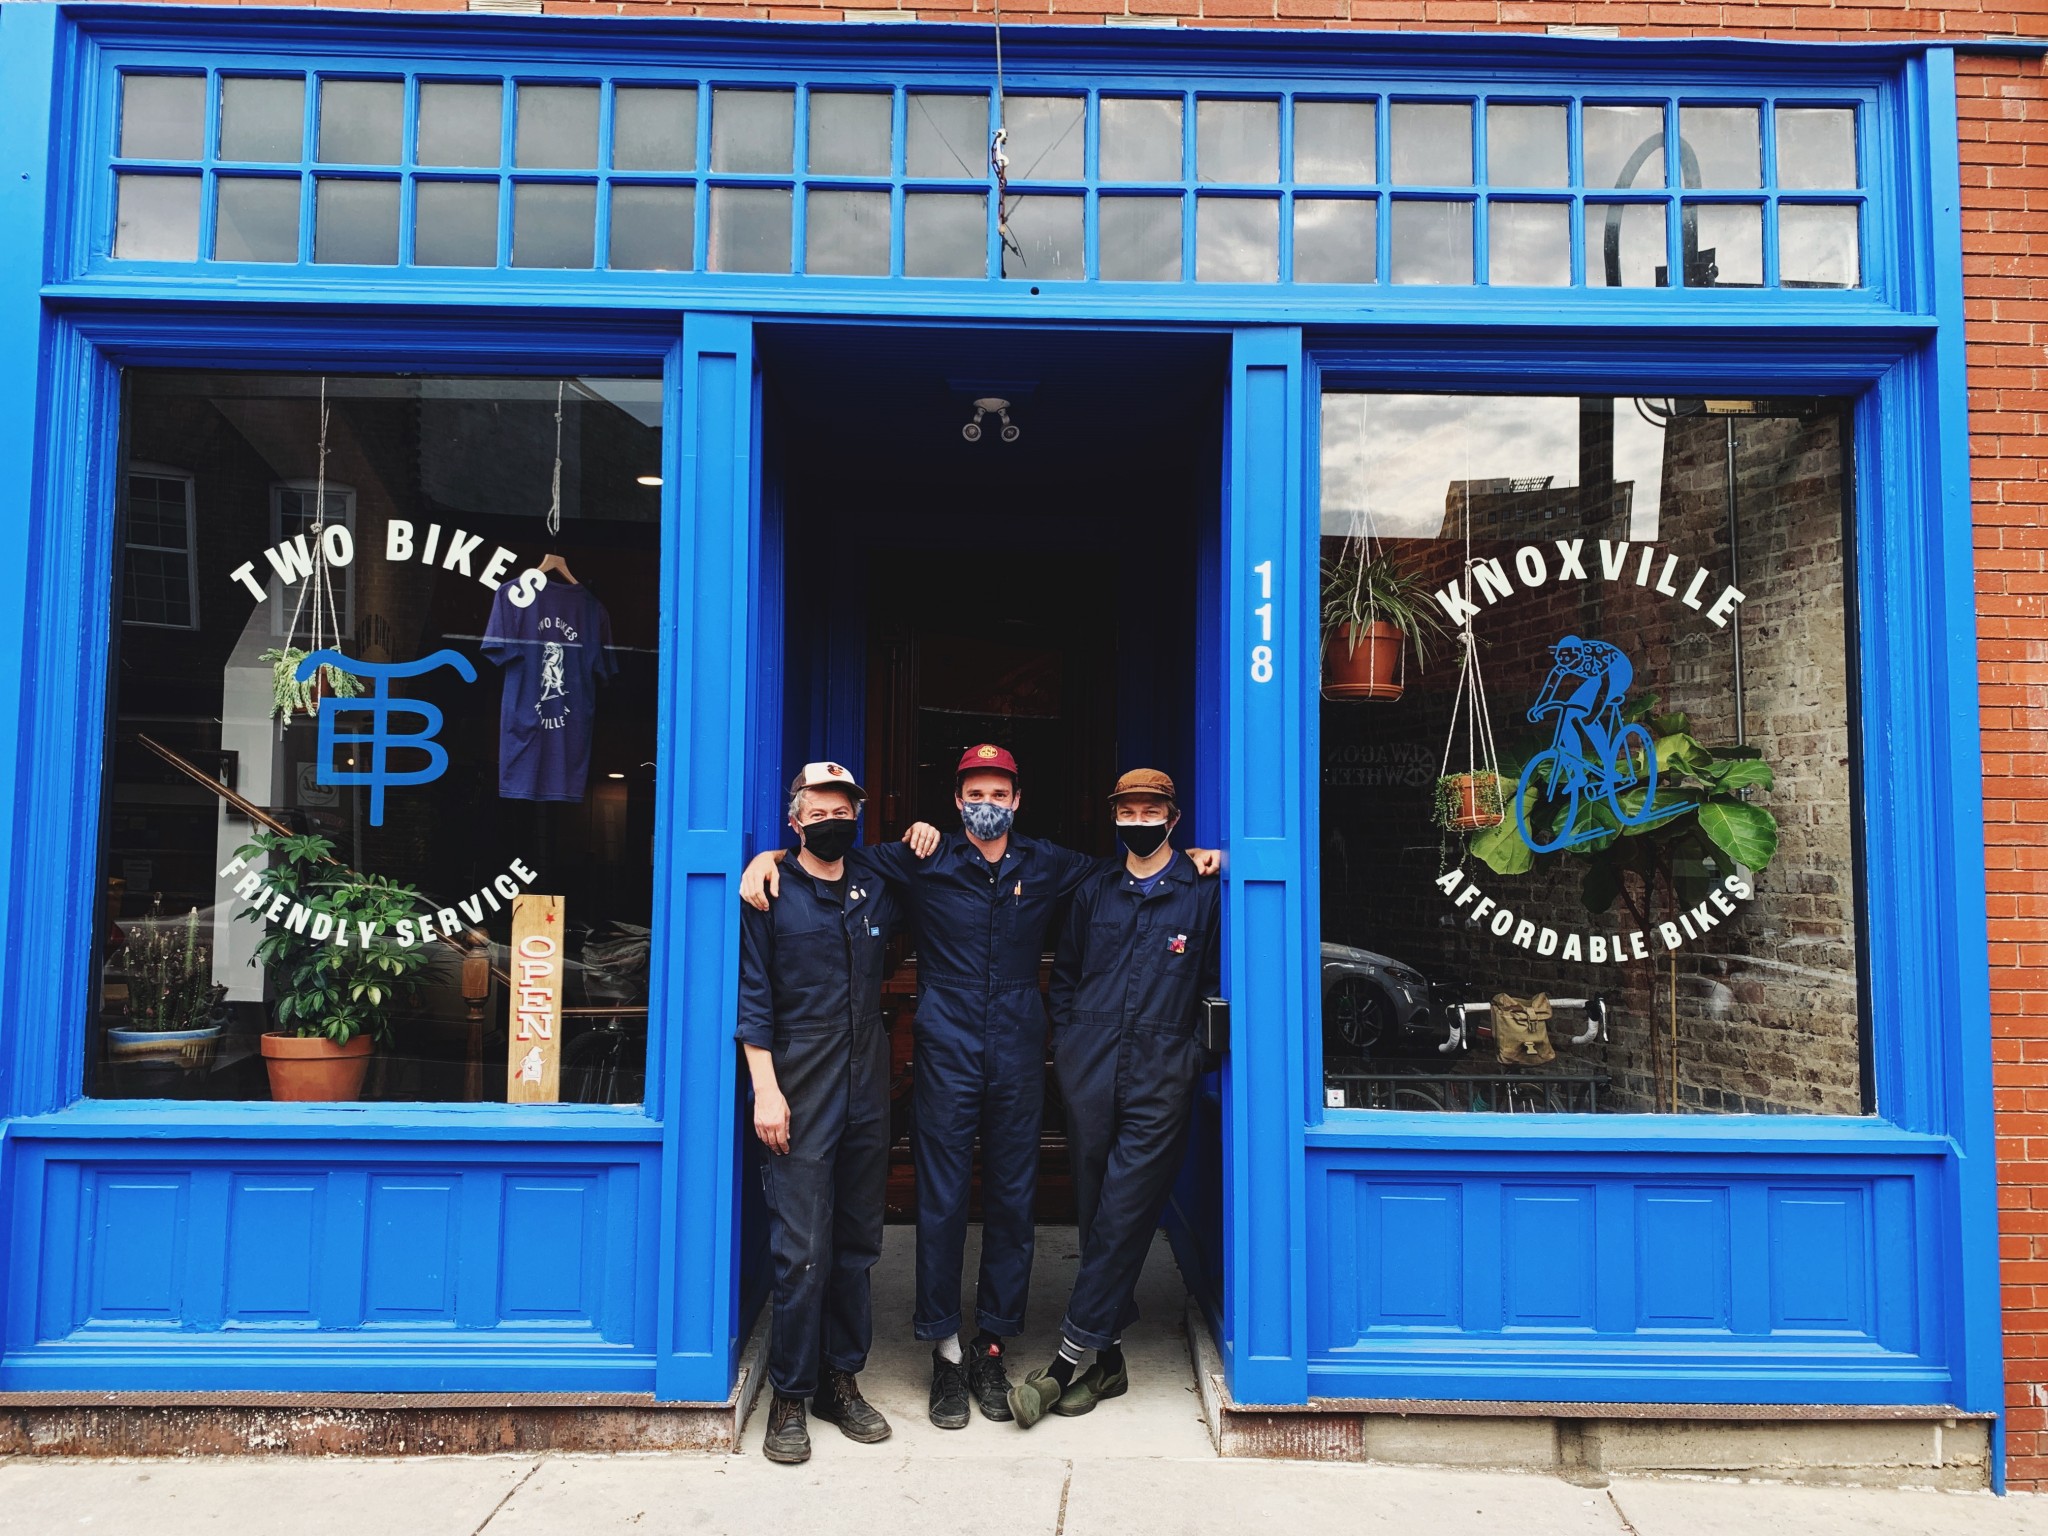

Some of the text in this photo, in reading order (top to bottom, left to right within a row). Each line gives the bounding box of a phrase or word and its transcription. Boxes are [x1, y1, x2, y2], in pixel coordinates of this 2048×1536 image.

[230, 519, 548, 608] TWO BIKES
[1434, 538, 1746, 628] KNOXVILLE
[537, 617, 552, 635] WO
[1251, 560, 1273, 683] 118
[219, 856, 538, 949] FRIENDLY SERVICE
[1435, 867, 1751, 963] AFFORDABLE BIKES
[516, 935, 557, 1041] OPEN
